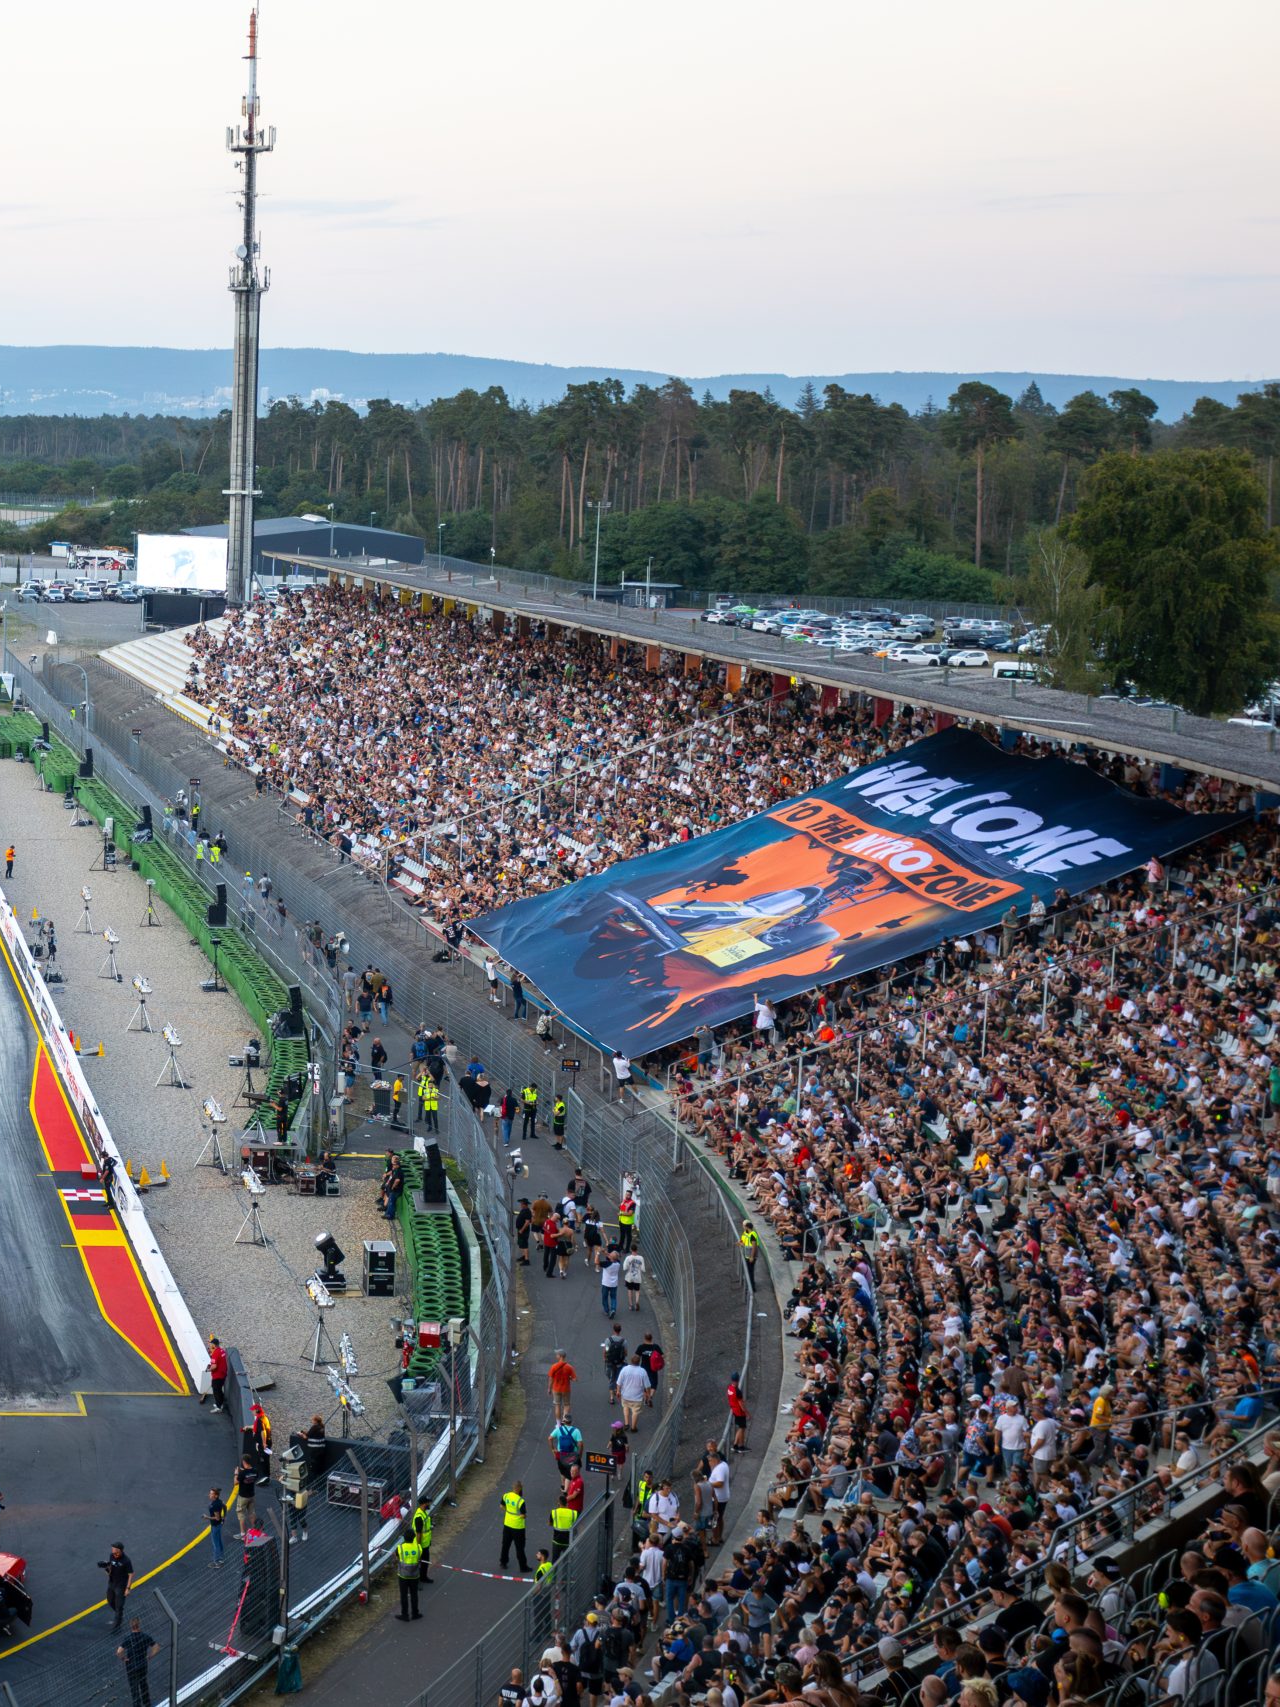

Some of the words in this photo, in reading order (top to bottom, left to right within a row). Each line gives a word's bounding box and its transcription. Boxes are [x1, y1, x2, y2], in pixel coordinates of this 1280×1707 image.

[776, 801, 823, 823] TO
[806, 813, 865, 845] THE
[905, 864, 1007, 908] ZONE
[844, 760, 1133, 881] WELCOME
[589, 1455, 607, 1463] SÜD
